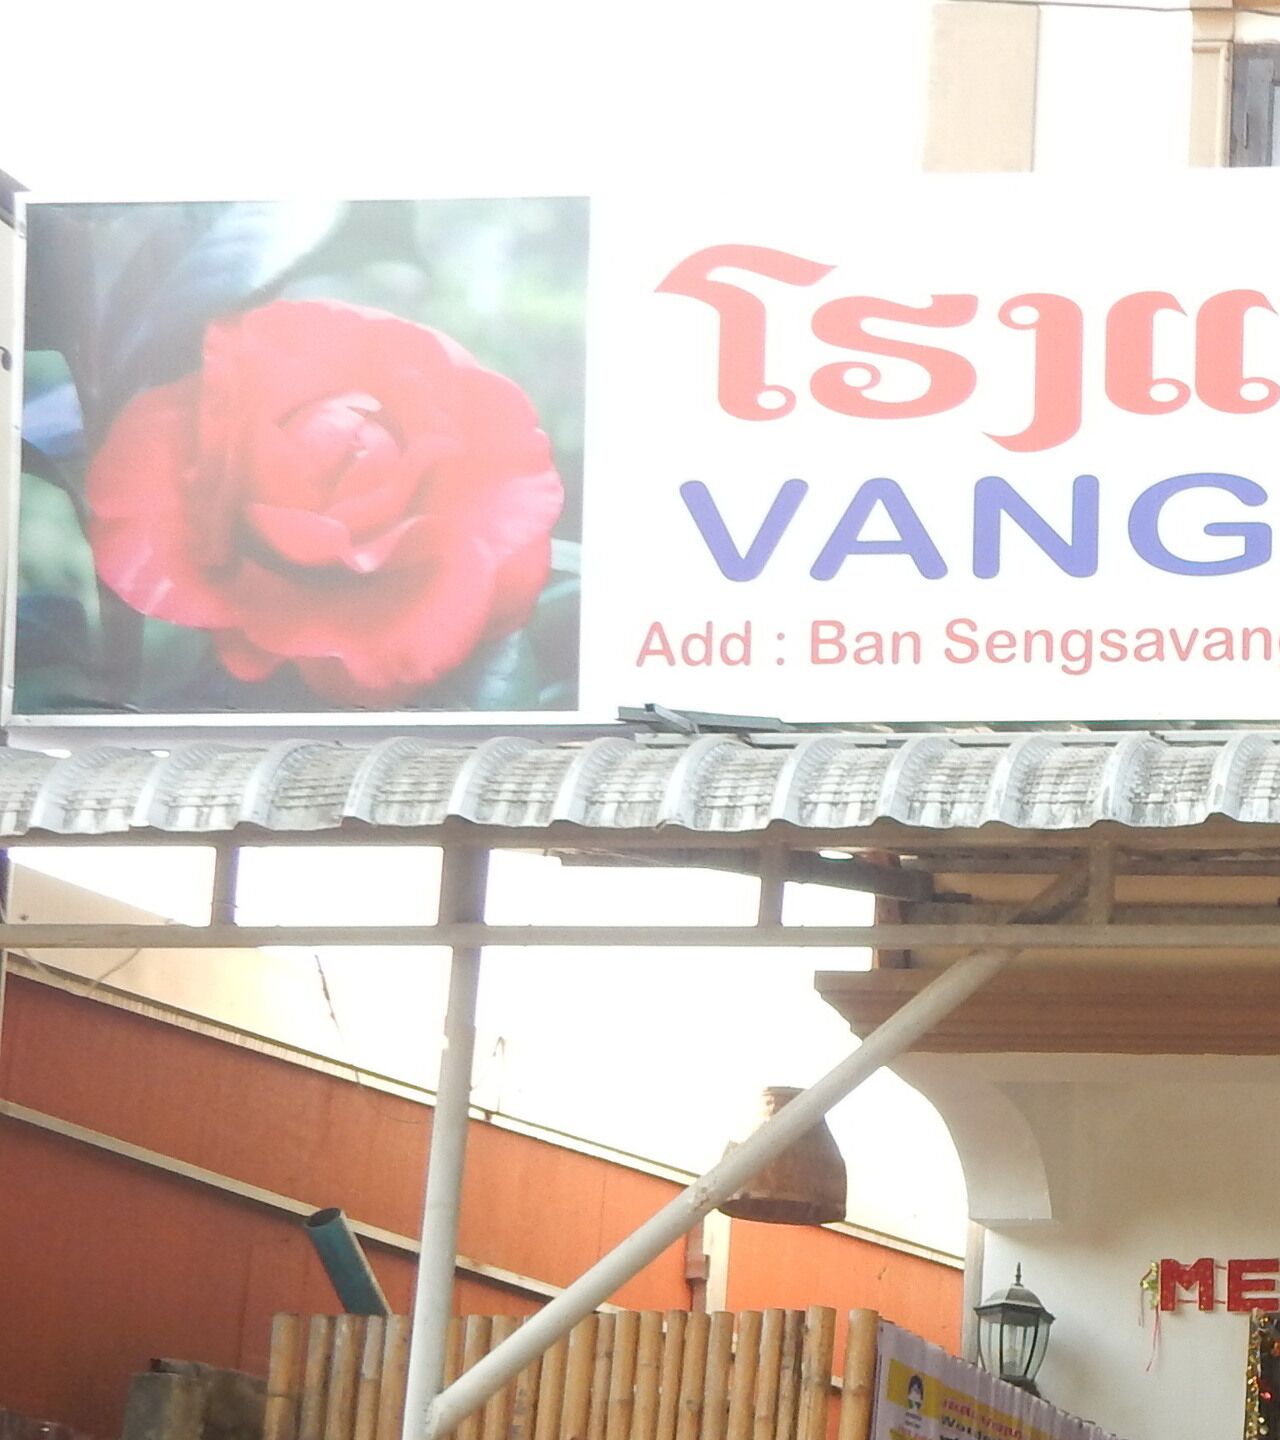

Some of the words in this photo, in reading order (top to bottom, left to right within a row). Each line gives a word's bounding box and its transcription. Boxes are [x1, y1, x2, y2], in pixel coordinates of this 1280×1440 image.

[680, 472, 1273, 582] VANG
[637, 622, 752, 667] Add
[810, 620, 921, 665] Ban
